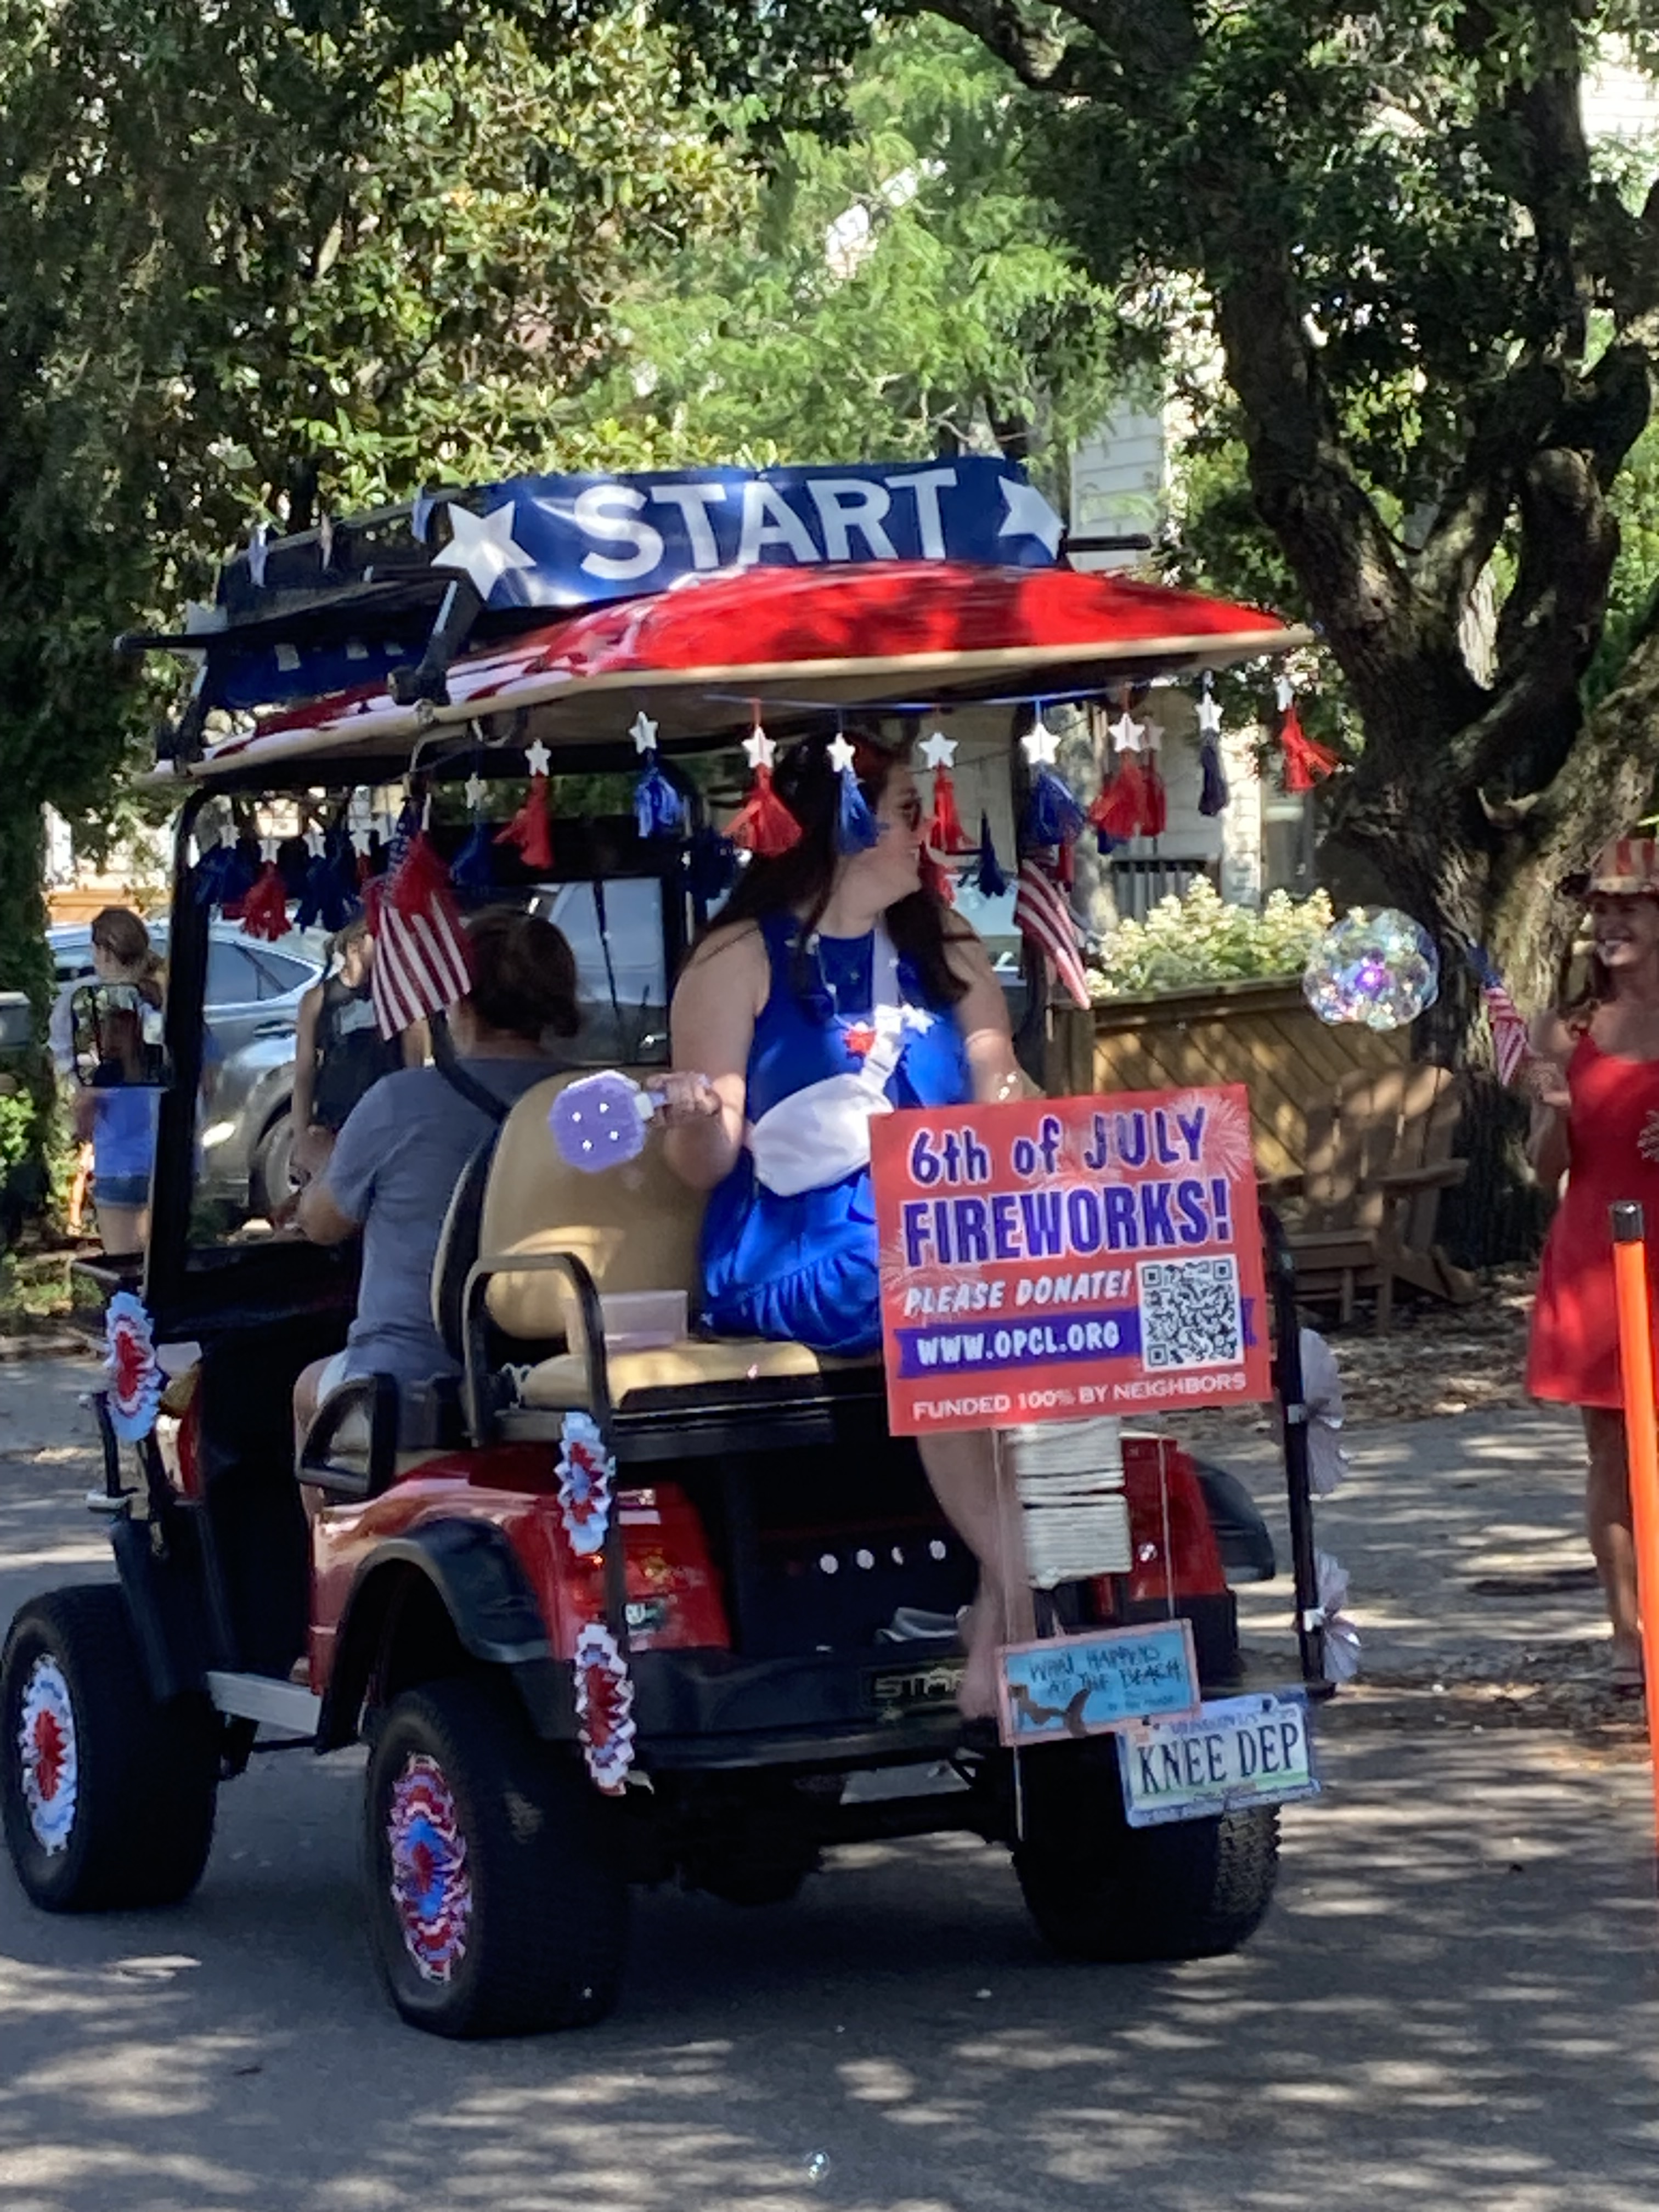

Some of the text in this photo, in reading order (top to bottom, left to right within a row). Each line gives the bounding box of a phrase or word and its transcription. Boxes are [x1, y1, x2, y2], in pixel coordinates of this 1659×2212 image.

[573, 469, 957, 580] START
[910, 1106, 1206, 1185] 6th of JULY
[902, 1178, 1229, 1267] FIREWORKS!
[904, 1268, 1132, 1316] PLEASE DONATE!
[917, 1320, 1120, 1366] WWW.OPCL.ORG
[913, 1372, 1247, 1421] FUNDED 100% BY NEIGHBORS
[1137, 1722, 1300, 1795] KNEE DEP
